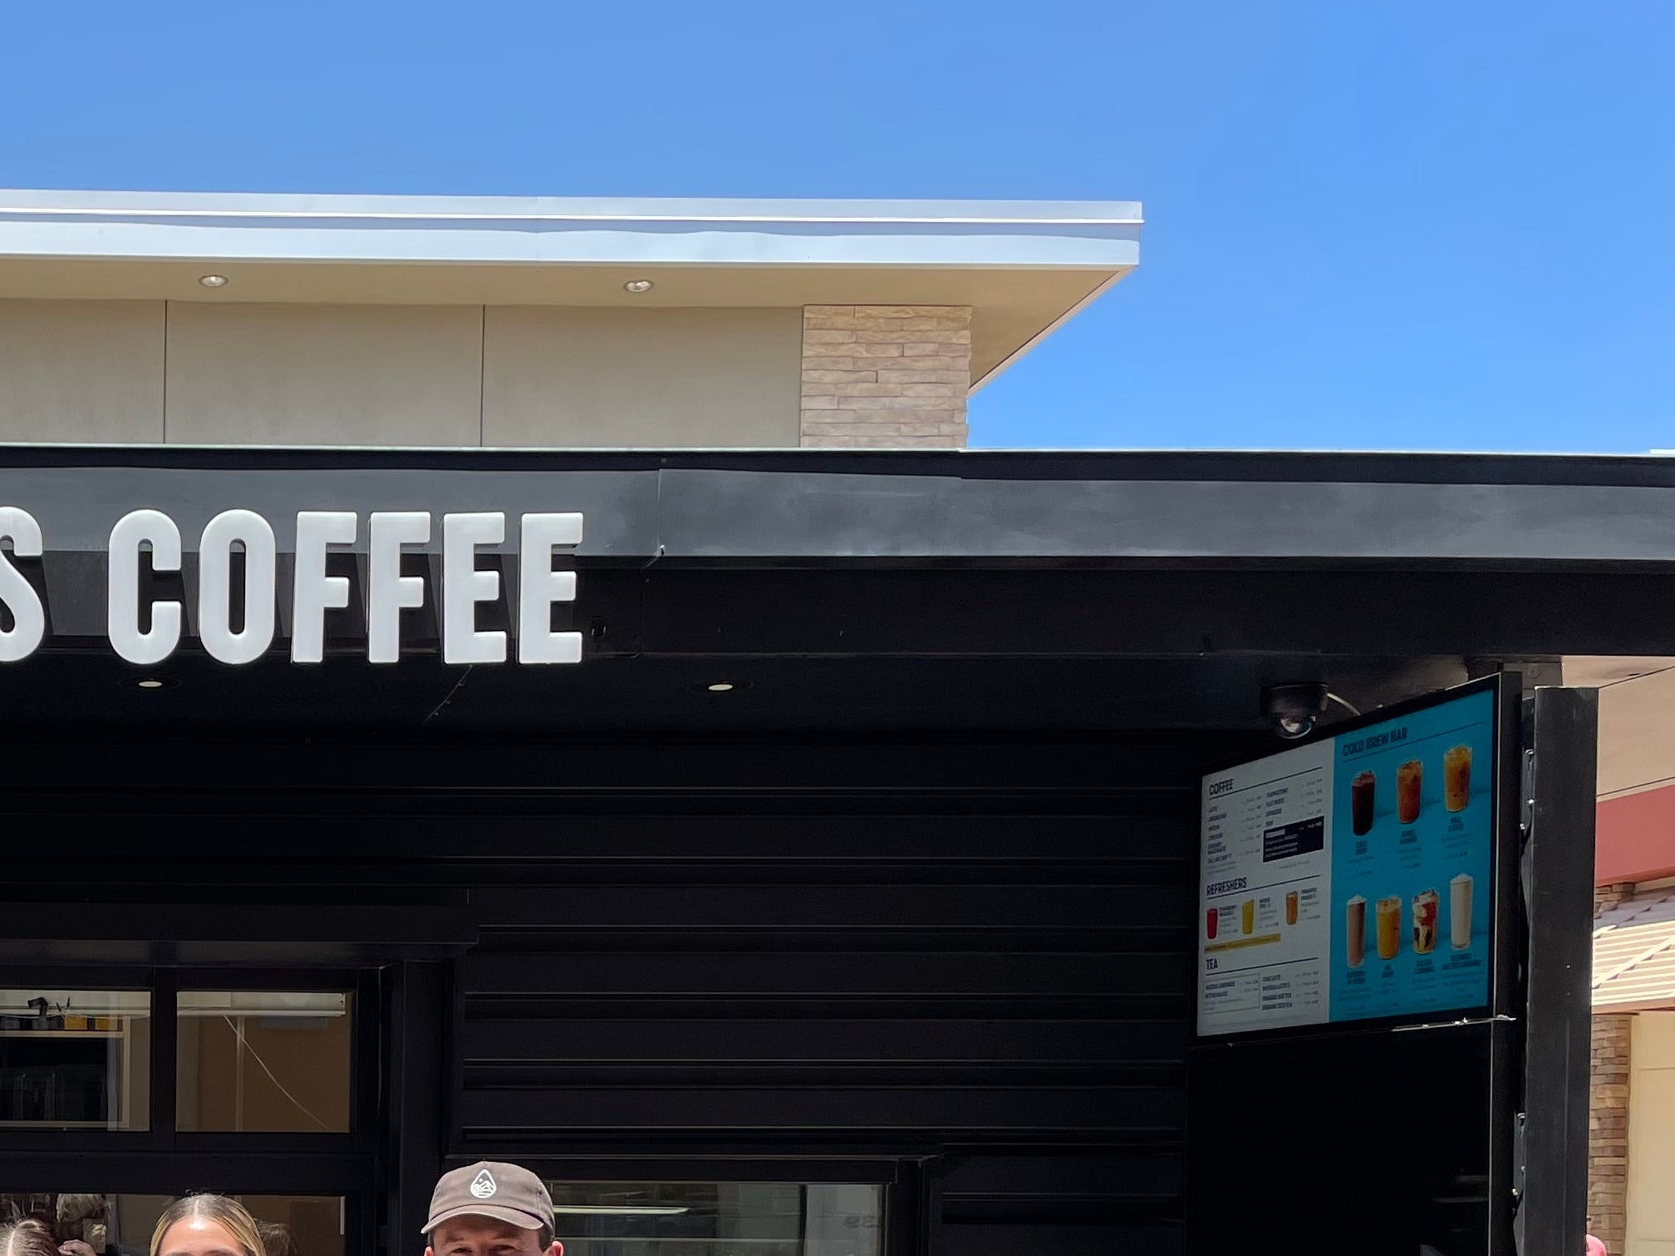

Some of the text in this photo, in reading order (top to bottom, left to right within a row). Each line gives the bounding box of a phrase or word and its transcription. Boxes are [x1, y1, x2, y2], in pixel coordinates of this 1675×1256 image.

[107, 508, 584, 665] COFFEE
[1342, 727, 1408, 757] COLD BREW BAR
[1209, 778, 1234, 796] COFFEE
[1206, 876, 1247, 896] REFRESHERS
[1206, 958, 1218, 971] TEA
